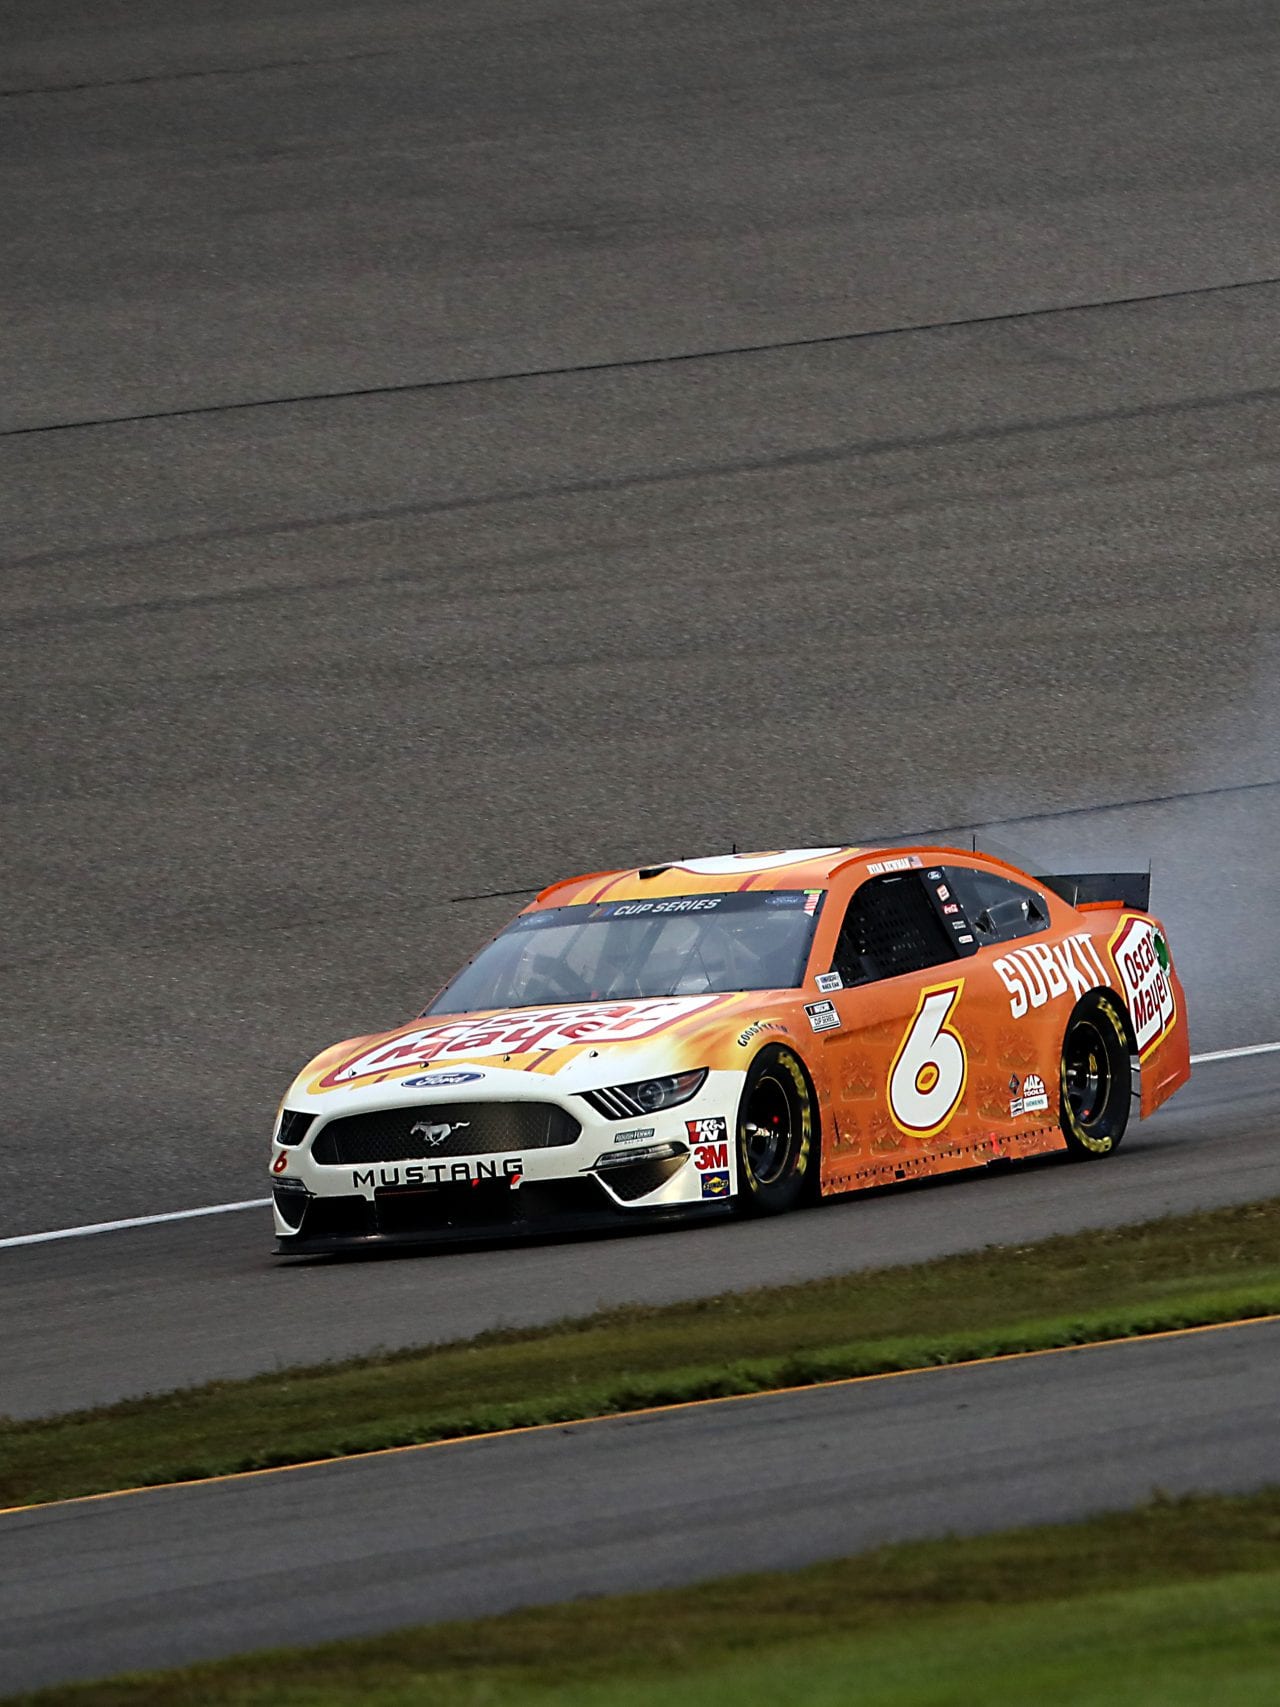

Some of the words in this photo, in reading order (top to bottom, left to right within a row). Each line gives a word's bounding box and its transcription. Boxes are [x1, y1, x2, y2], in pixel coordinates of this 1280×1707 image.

[613, 903, 652, 917] CUP
[649, 898, 722, 914] SERIES
[992, 933, 1112, 1019] SUBKIT
[1132, 969, 1168, 1034] Mayer
[886, 977, 969, 1139] 6
[273, 1150, 288, 1174] 6
[694, 1143, 729, 1170] 3M
[353, 1158, 523, 1188] MUSTANG
